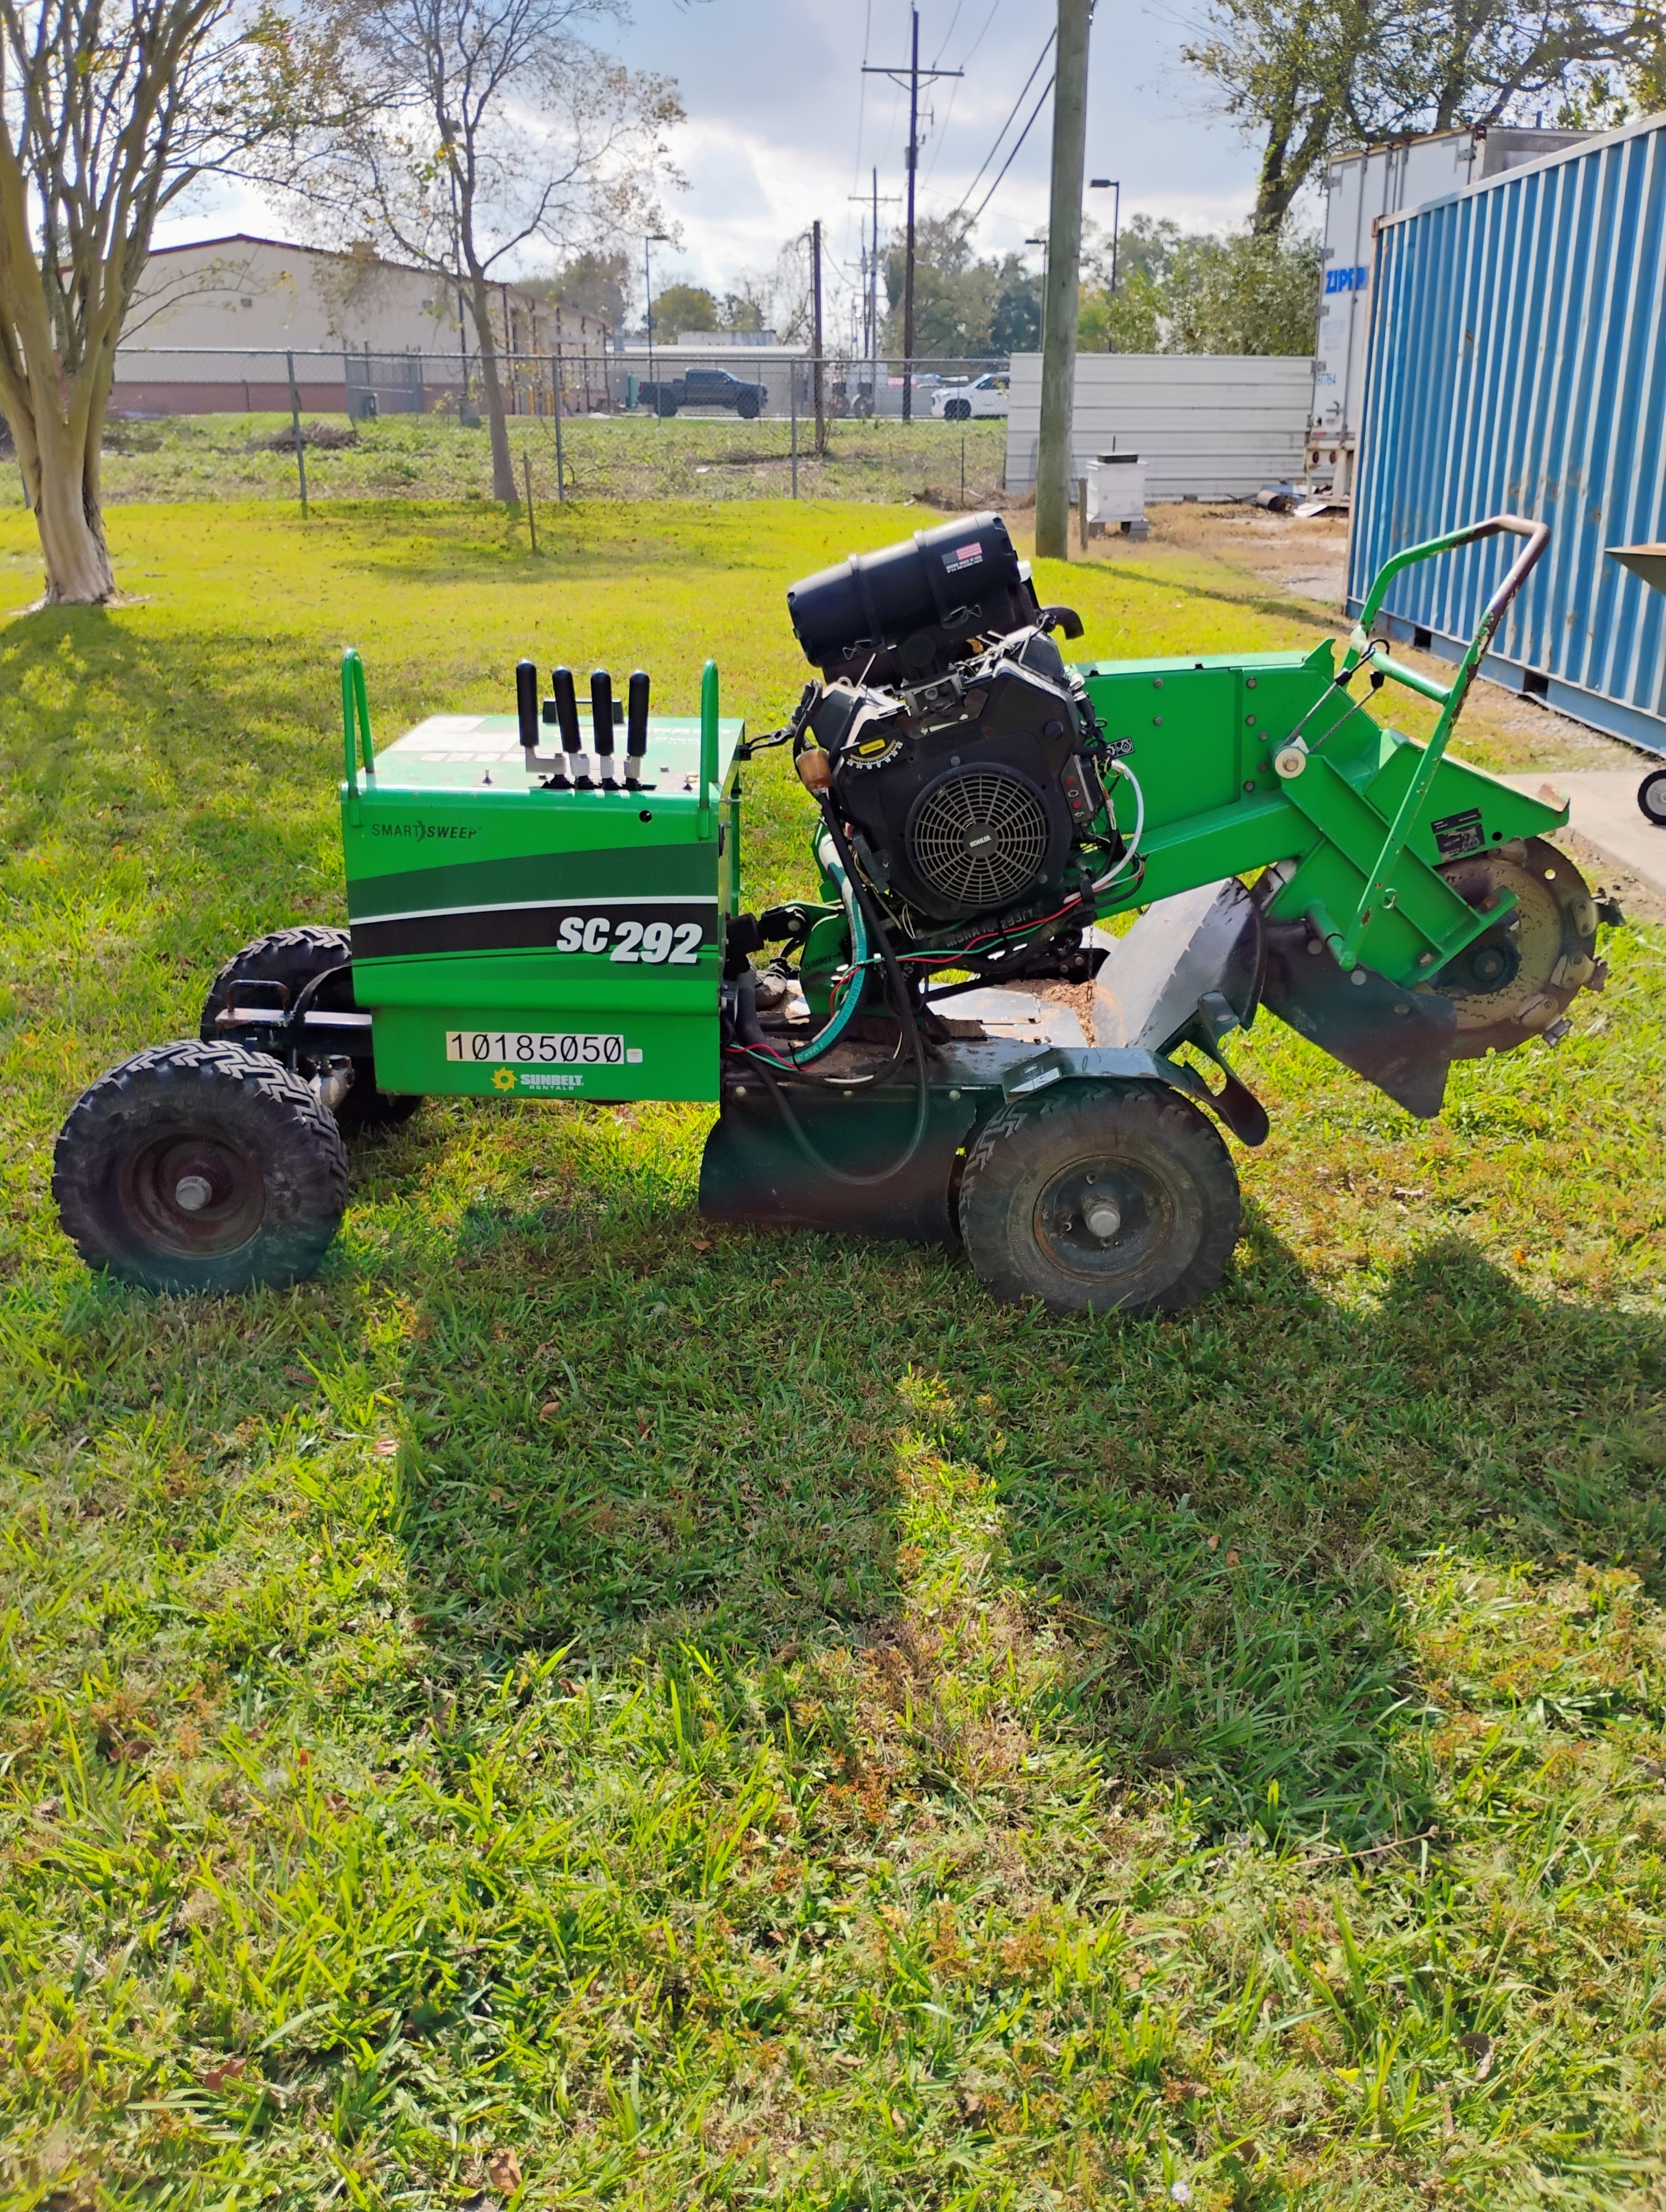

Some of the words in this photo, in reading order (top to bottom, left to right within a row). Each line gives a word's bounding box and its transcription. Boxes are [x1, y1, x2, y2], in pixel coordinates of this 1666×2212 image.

[863, 743, 881, 751] Vermeer
[969, 835, 992, 848] KOHLER
[556, 917, 611, 953] SC
[610, 921, 703, 963] 292
[451, 1032, 621, 1063] 10185050
[521, 1074, 583, 1086] SUNBELT
